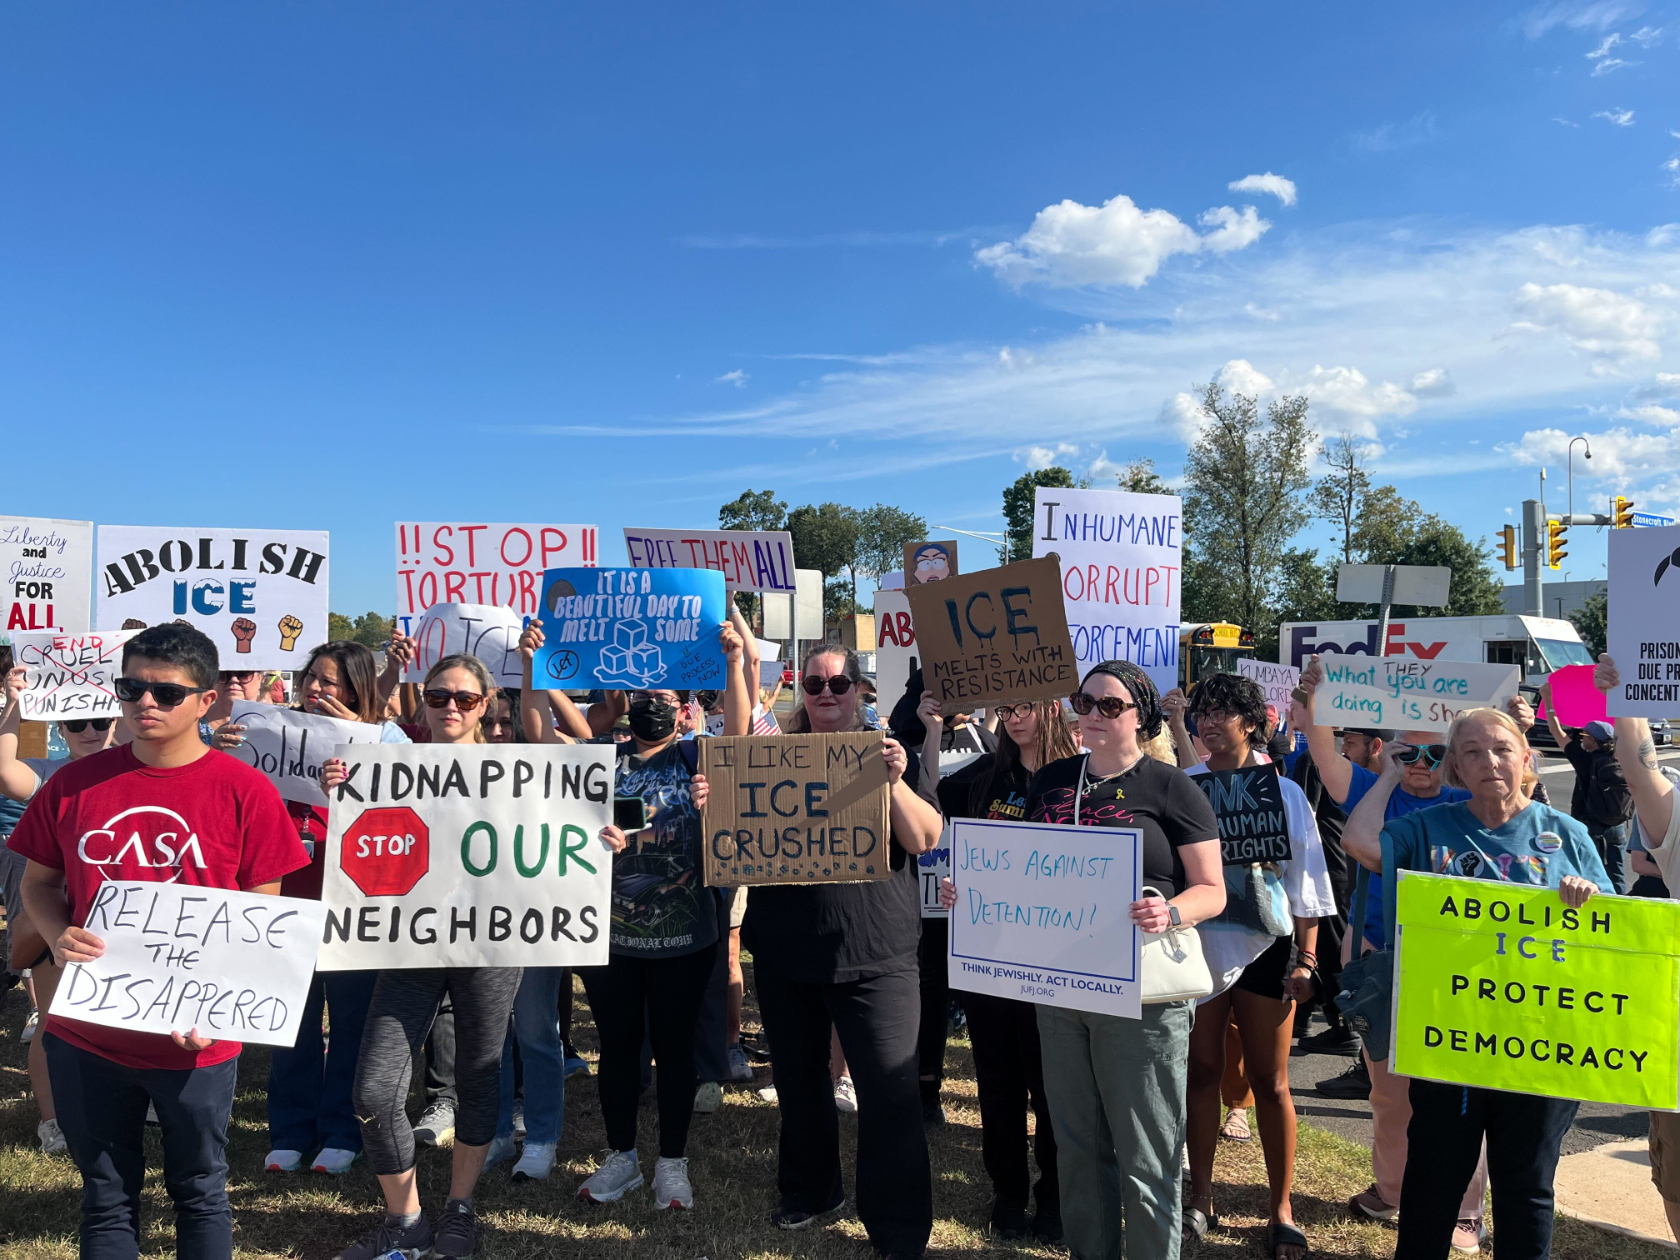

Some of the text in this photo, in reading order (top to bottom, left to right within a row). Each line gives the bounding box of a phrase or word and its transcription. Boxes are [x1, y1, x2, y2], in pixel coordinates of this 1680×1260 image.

[1041, 502, 1179, 549] INHUMANE
[1633, 514, 1661, 527] Stonecroft
[0, 525, 67, 554] Liberty
[22, 547, 47, 558] and
[8, 561, 65, 584] Justice
[103, 538, 326, 598] ABOLISH
[597, 570, 651, 594] IT IS A
[1059, 562, 1178, 607] ORRUPT
[15, 581, 53, 599] FOR
[172, 577, 256, 615] ICE
[398, 569, 545, 613] TORTUR
[554, 594, 702, 619] BEAUTIFUL DAY TO
[559, 618, 610, 643] MELT
[654, 618, 702, 642] SOME
[878, 611, 915, 648] AB
[944, 586, 1041, 650] ICE
[1213, 628, 1239, 638] SCHOOL BUS
[20, 644, 113, 668] CRUEL
[53, 636, 103, 652] END
[404, 617, 446, 673] NO
[934, 653, 1002, 678] MELTS
[1012, 645, 1063, 665] WITH
[1068, 624, 1180, 667] ORCEMENT
[24, 670, 116, 690] UNUS
[941, 665, 1071, 700] RESISTANCE
[1325, 663, 1468, 698] What you are
[1384, 662, 1433, 677] THEY
[1638, 663, 1661, 680] DUE
[23, 693, 121, 715] PUNISHM
[1332, 692, 1382, 724] doing
[1402, 698, 1422, 720] is
[1625, 684, 1680, 701] CONCENT
[233, 712, 323, 780] Solida
[714, 743, 869, 771] I LIKE MY
[337, 758, 609, 804] KIDNAPPING
[739, 779, 829, 818] ICE
[1201, 770, 1259, 814] ONK
[77, 828, 208, 869] CASA
[356, 833, 416, 858] STOP
[460, 820, 598, 878] OUR
[712, 826, 877, 861] CRUSHED
[960, 839, 1114, 880] JEWS AGAINST
[1221, 835, 1288, 861] RIGHTS
[86, 885, 298, 949] RELEASE
[322, 904, 599, 944] NEIGHBORS
[968, 887, 1097, 938] DETENTION!
[1440, 895, 1610, 934] ABOLISH
[145, 943, 199, 970] THE
[1496, 932, 1565, 962] ICE
[961, 962, 1124, 996] THINK JEWISHLY. ACT LOCALLY.
[1020, 984, 1055, 997] JUFJ.ORG
[1452, 974, 1629, 1015] PROTECT
[67, 963, 288, 1032] DISAPPERED
[1424, 1025, 1648, 1072] DEMOCRACY
